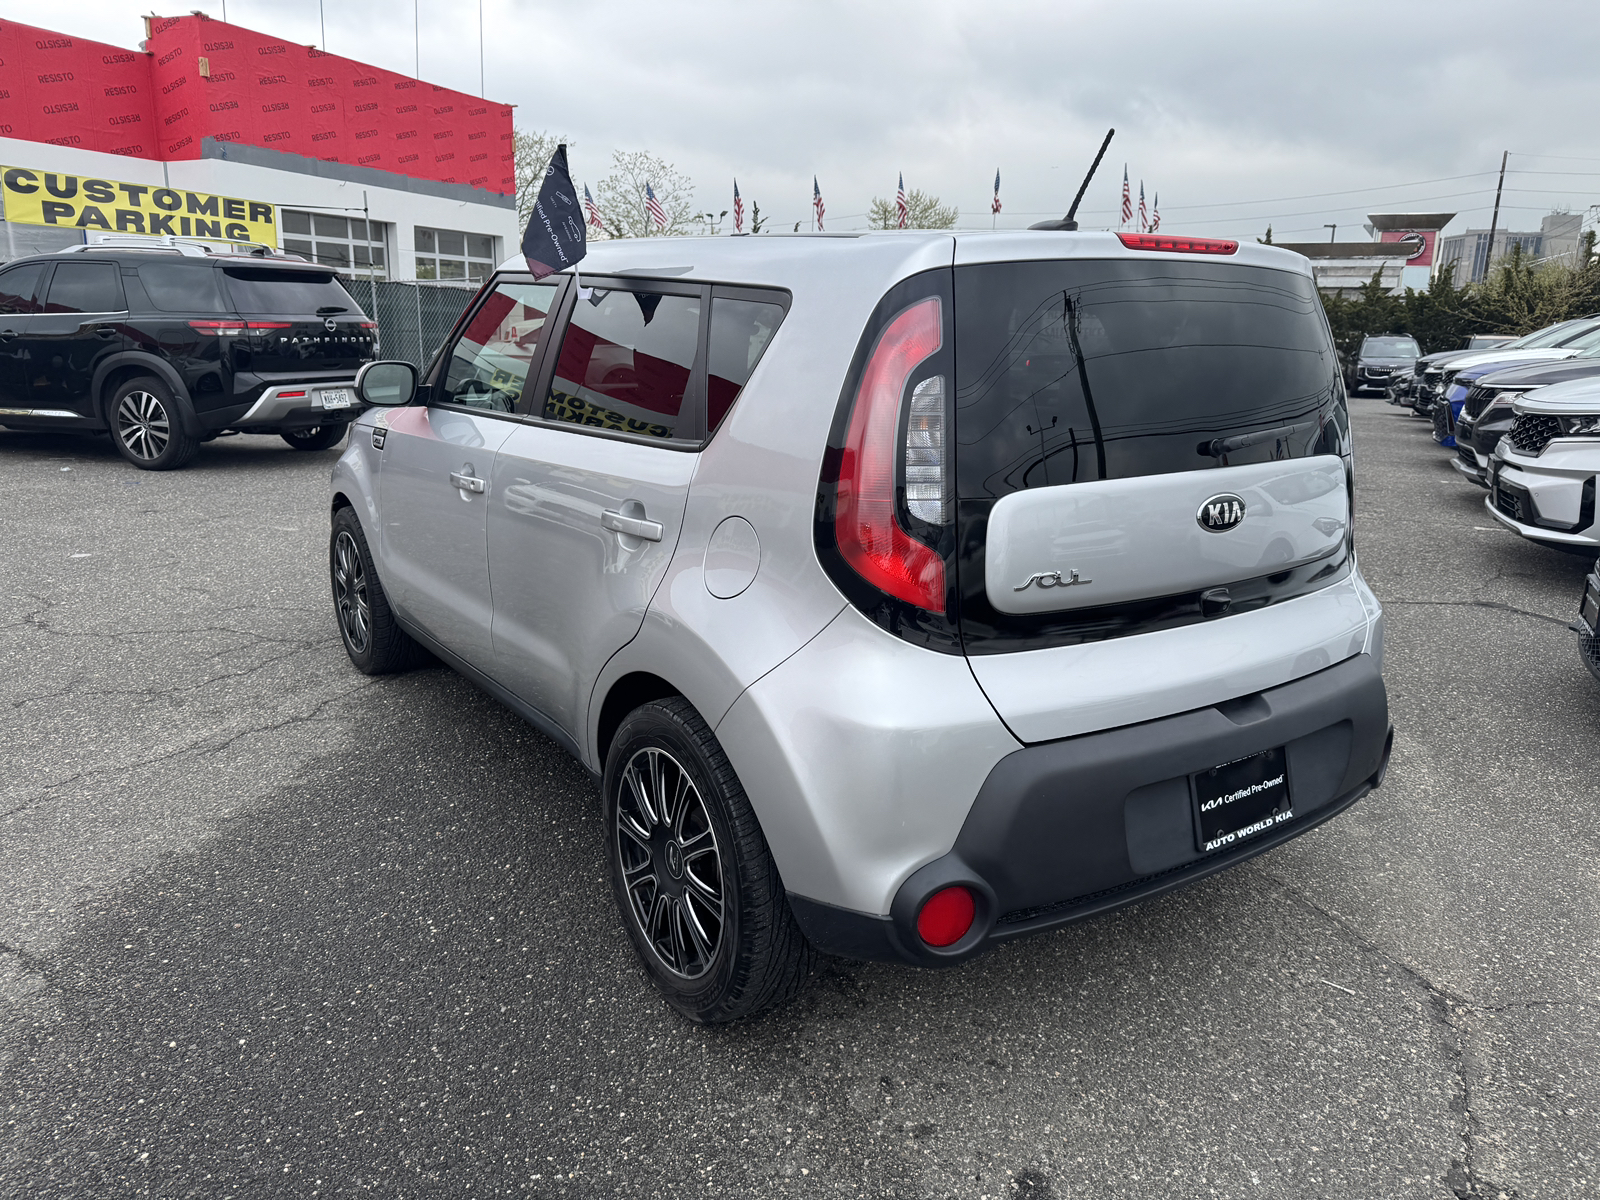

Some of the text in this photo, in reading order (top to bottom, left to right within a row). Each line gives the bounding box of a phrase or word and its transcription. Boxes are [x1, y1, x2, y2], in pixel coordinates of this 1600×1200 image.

[155, 16, 180, 34] RESISTO
[36, 39, 72, 50] RESISTO
[204, 42, 234, 52] RESISTO
[258, 46, 286, 56] RESISTO
[102, 53, 135, 64] RESISTO
[158, 48, 182, 66] RESISTO
[38, 72, 74, 84] RESISTO
[206, 72, 235, 82] RESISTO
[259, 75, 286, 86] RESISTO
[162, 76, 186, 94] RESISTO
[308, 78, 334, 87] RESISTO
[353, 78, 376, 87] RESISTO
[395, 81, 416, 90] RESISTO
[104, 86, 136, 96] RESISTO
[43, 102, 79, 114] RESISTO
[210, 101, 238, 112] RESISTO
[262, 102, 290, 112] RESISTO
[311, 103, 336, 114] RESISTO
[355, 102, 378, 112] RESISTO
[396, 104, 418, 114] RESISTO
[434, 106, 454, 115] RESISTO
[164, 108, 188, 126] RESISTO
[468, 108, 486, 116] RESISTO
[109, 114, 141, 126] RESISTO
[264, 131, 290, 142] RESISTO
[312, 131, 336, 142] RESISTO
[355, 130, 378, 139] RESISTO
[396, 130, 417, 140] RESISTO
[434, 130, 453, 140] RESISTO
[468, 132, 486, 140] RESISTO
[169, 136, 193, 154] RESISTO
[358, 154, 380, 164] RESISTO
[398, 154, 419, 164] RESISTO
[435, 153, 454, 162] RESISTO
[470, 154, 488, 162] RESISTO
[470, 176, 488, 185] RESISTO
[4, 168, 272, 224] CUSTOMER
[42, 200, 250, 242] PARKING
[1208, 500, 1242, 526] KIA
[1014, 568, 1092, 592] SOUL
[1224, 786, 1251, 804] Certified
[1251, 774, 1284, 794] Pre-Owned
[1205, 810, 1293, 851] AUTO WORLD KIA
